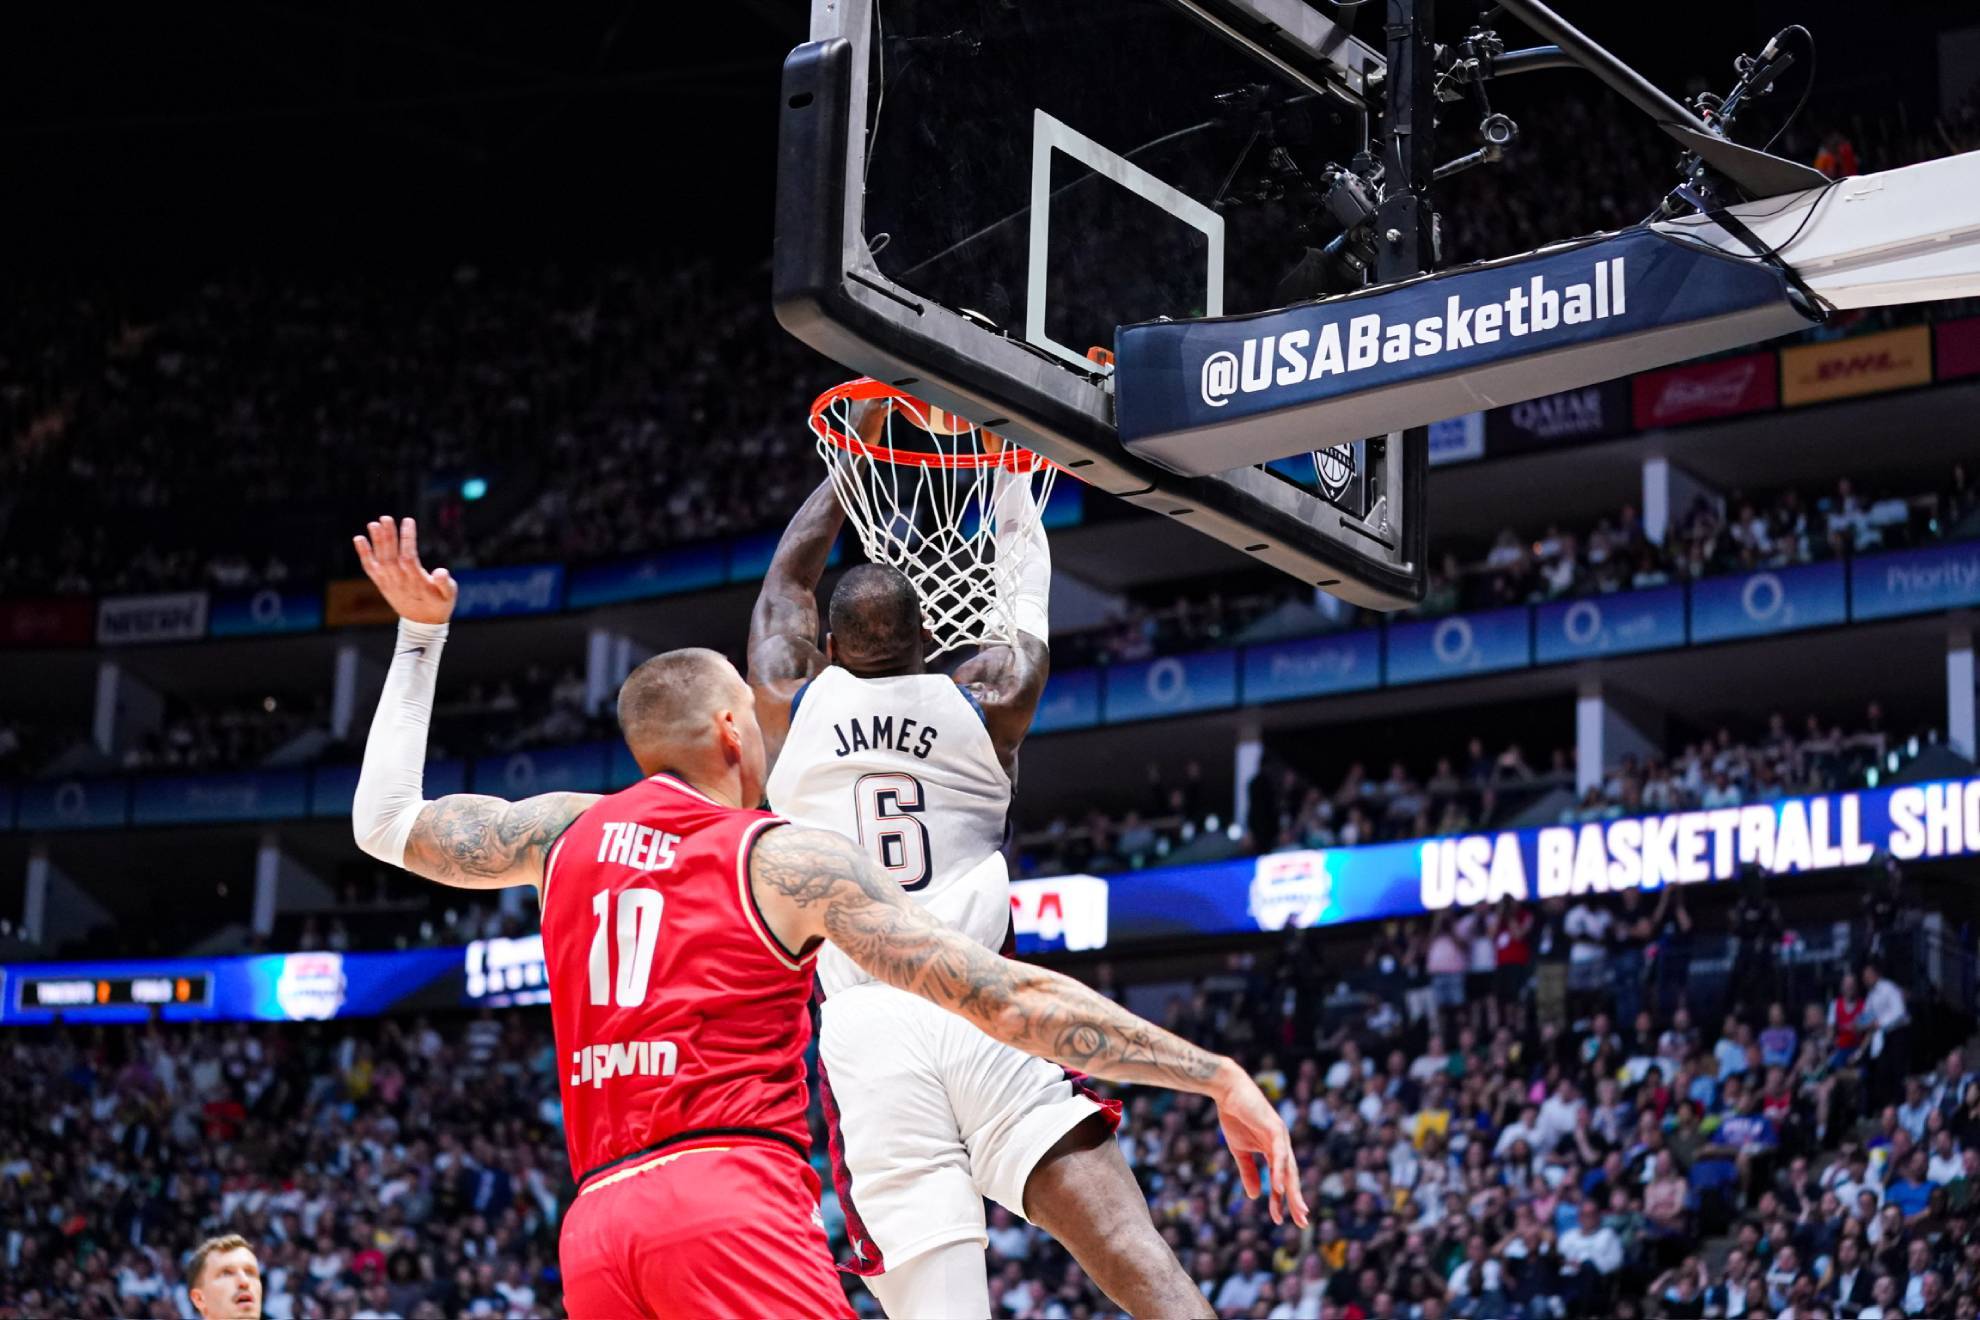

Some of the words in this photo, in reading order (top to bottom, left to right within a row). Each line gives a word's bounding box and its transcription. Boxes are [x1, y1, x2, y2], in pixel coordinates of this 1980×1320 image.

[1201, 256, 1626, 407] @USABasketball
[833, 715, 938, 759] JAMES
[597, 821, 682, 872] THEIS
[854, 771, 933, 892] 6
[1420, 832, 1529, 911] USA
[1537, 794, 1875, 899] BASKETBALL
[588, 887, 665, 1008] 10
